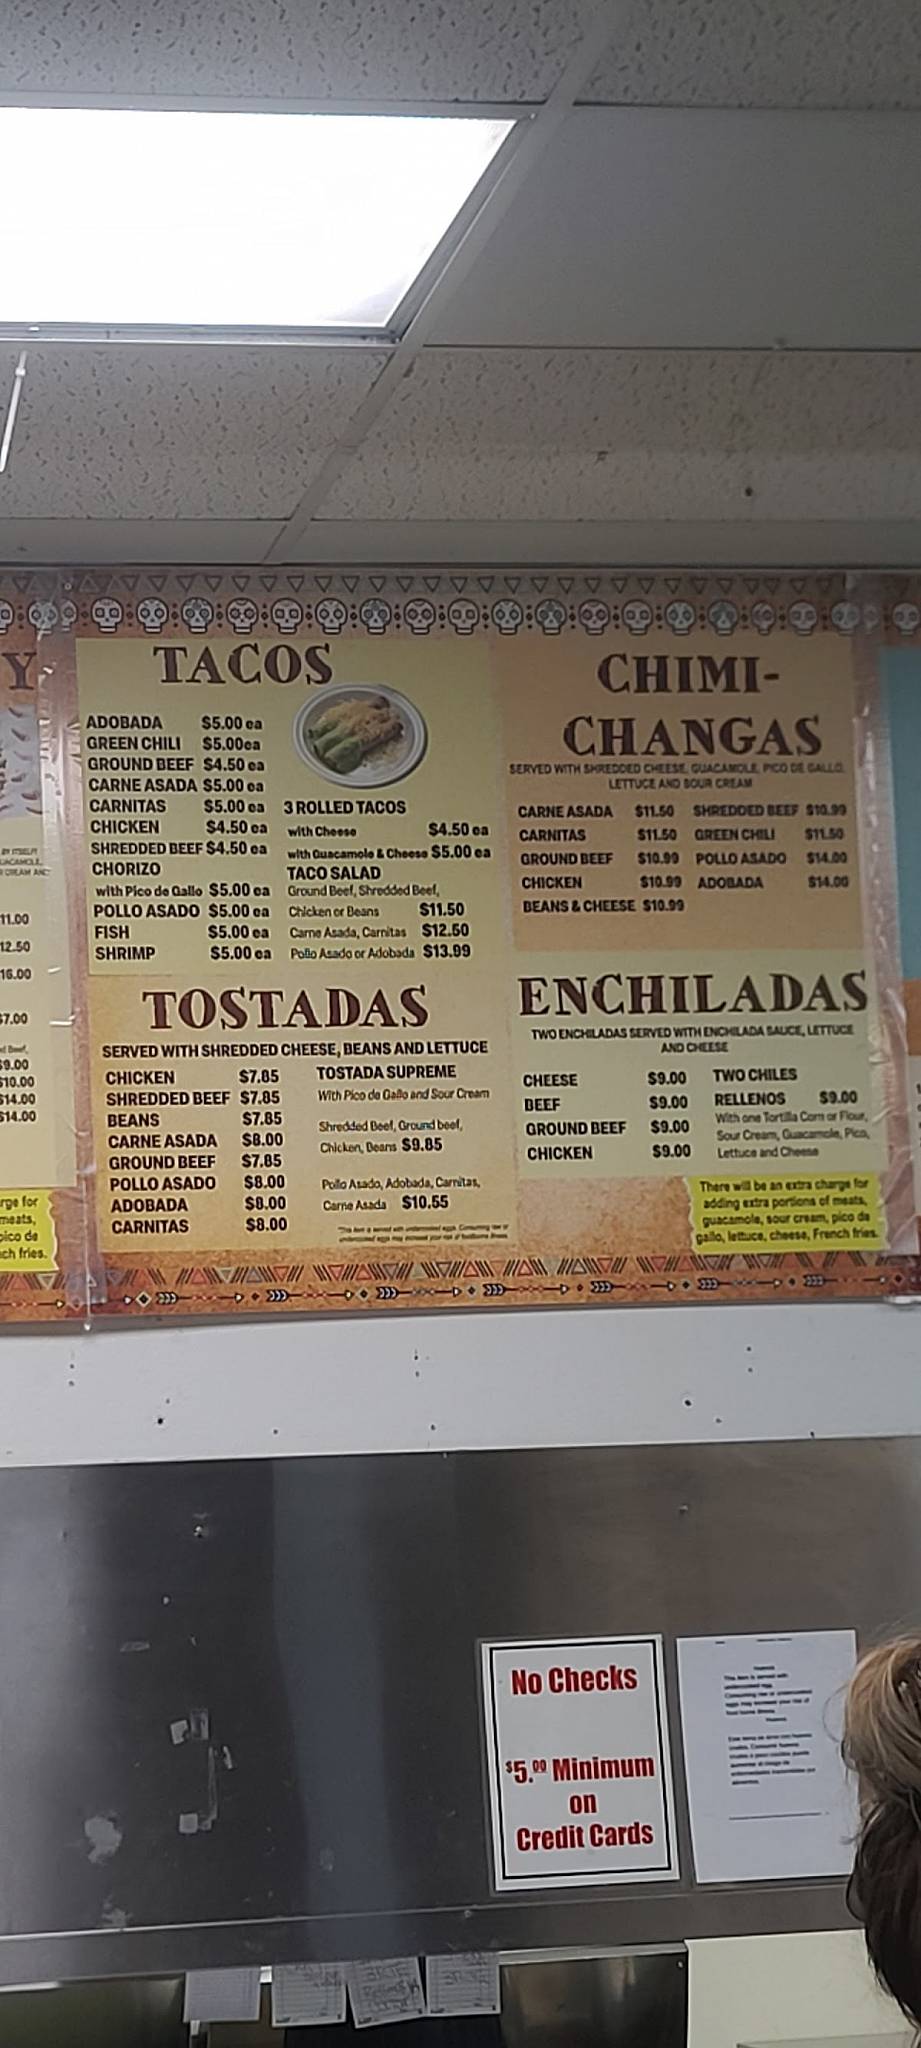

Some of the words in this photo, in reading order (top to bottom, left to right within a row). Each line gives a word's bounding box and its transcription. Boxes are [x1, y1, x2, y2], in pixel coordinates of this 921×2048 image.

[153, 643, 332, 685] TACOS
[597, 653, 780, 695] CHIMI-
[86, 716, 162, 730] ADOBADA
[201, 716, 243, 731] $5.00
[246, 719, 262, 730] ea
[563, 715, 823, 757] CHANGAS
[88, 758, 153, 771] GROUND
[156, 758, 194, 771] BEEF
[203, 758, 245, 772] $4.50
[248, 761, 264, 772] ea
[284, 801, 294, 814] 3
[296, 801, 353, 814] ROLLED
[356, 801, 406, 814] TACOS
[518, 806, 563, 819] CARNE
[566, 806, 613, 818] ASADA
[635, 805, 674, 818] $11.50
[693, 805, 764, 817] SHREDDED
[767, 805, 798, 816] BEEF
[288, 826, 313, 837] with
[315, 826, 357, 837] Cheese
[429, 823, 470, 837] $4.50
[472, 826, 489, 836] ea
[519, 829, 586, 842] CARNITAS
[637, 829, 677, 842] $11.50
[695, 829, 739, 841] GREEN
[741, 829, 775, 841] CHILI
[91, 842, 166, 855] SHREDDED
[169, 842, 203, 855] BEEF
[206, 841, 247, 856] $4.50
[250, 844, 267, 855] ea
[288, 849, 310, 860] with
[377, 849, 384, 859] &
[386, 848, 429, 859] Cheese
[431, 845, 472, 859] $5.00
[474, 848, 491, 859] ea
[520, 853, 578, 865] GROUND
[580, 853, 613, 864] BEEF
[637, 852, 679, 865] $10.99
[696, 853, 738, 865] POLLO
[741, 852, 786, 864] ASADO
[287, 867, 327, 880] TACO
[330, 866, 381, 880] SALAD
[521, 876, 582, 889] CHICKEN
[640, 876, 682, 889] $10.99
[698, 876, 763, 889] ADOBADA
[96, 885, 123, 897] with
[125, 885, 152, 897] Pico
[154, 885, 169, 897] de
[171, 885, 203, 897] Gallo
[208, 883, 251, 898] $5.00
[253, 886, 270, 897] ea
[93, 905, 142, 918] POLLO
[146, 904, 200, 918] ASADO
[208, 904, 250, 919] $5.00
[252, 907, 270, 918] ea
[523, 900, 569, 913] BEANS
[572, 900, 580, 912] &
[583, 900, 636, 912] CHEESE
[643, 899, 684, 913] $10.99
[95, 947, 155, 960] SHRIMP
[210, 946, 252, 961] $5.00
[254, 950, 271, 960] ea
[518, 970, 868, 1017] ENCHILADAS
[142, 985, 429, 1031] TOSTADAS
[531, 1028, 557, 1040] TWO
[559, 1027, 628, 1040] ENCHILADAS
[630, 1027, 672, 1039] SERVED
[674, 1026, 701, 1038] WITH
[703, 1026, 764, 1038] ENCHILADA
[808, 1024, 854, 1036] LETTUCE
[102, 1044, 159, 1059] SERVED
[162, 1044, 199, 1058] WITH
[201, 1043, 279, 1057] SHREDDED
[343, 1042, 391, 1055] BEANS
[394, 1041, 425, 1055] AND
[427, 1041, 488, 1055] LETTUCE
[661, 1042, 685, 1053] AND
[687, 1041, 728, 1053] CHEESE
[106, 1070, 175, 1086] CHICKEN
[239, 1068, 280, 1085] $7.85
[316, 1066, 384, 1081] TOSTADA
[386, 1065, 456, 1080] SUPREME
[523, 1073, 578, 1088] CHEESE
[647, 1071, 687, 1086] $9.00
[713, 1069, 745, 1083] TWO
[748, 1068, 797, 1082] CHILES
[524, 1098, 561, 1112] BEEF
[649, 1096, 688, 1111] $9.00
[714, 1092, 786, 1107] RELLENOS
[819, 1090, 858, 1105] $9.00
[107, 1113, 159, 1128] BEANS
[242, 1111, 282, 1128] $7.85
[526, 1122, 589, 1136] GROUND
[590, 1121, 626, 1134] BEEF
[650, 1120, 690, 1135] $9.00
[108, 1135, 162, 1149] CARNE
[164, 1133, 217, 1149] ASADA
[242, 1132, 284, 1149] $8.00
[401, 1137, 443, 1153] $9.85
[527, 1147, 593, 1161] CHICKEN
[652, 1144, 691, 1159] $9.00
[110, 1177, 160, 1192] POLLO
[162, 1176, 216, 1191] ASADO
[244, 1174, 285, 1190] $8.00
[700, 1180, 730, 1192] There
[733, 1180, 751, 1192] will
[754, 1180, 767, 1191] be
[769, 1182, 783, 1191] an
[785, 1180, 812, 1191] extra
[814, 1179, 851, 1192] charge
[853, 1178, 868, 1190] for
[401, 1195, 449, 1211] $10.55
[704, 1197, 739, 1211] adding
[743, 1198, 769, 1209] extra
[772, 1196, 817, 1211] portions
[820, 1196, 830, 1207] of
[112, 1219, 189, 1235] CARNITAS
[246, 1217, 288, 1233] $8.00
[766, 1215, 790, 1225] sour
[831, 1213, 854, 1226] pico
[856, 1212, 870, 1222] de
[813, 1228, 849, 1240] French
[511, 1669, 542, 1695] No
[548, 1665, 638, 1693] Checks
[552, 1756, 655, 1782] Minimum
[569, 1794, 597, 1814] on
[516, 1826, 584, 1851] Credit
[590, 1822, 654, 1848] Cards
